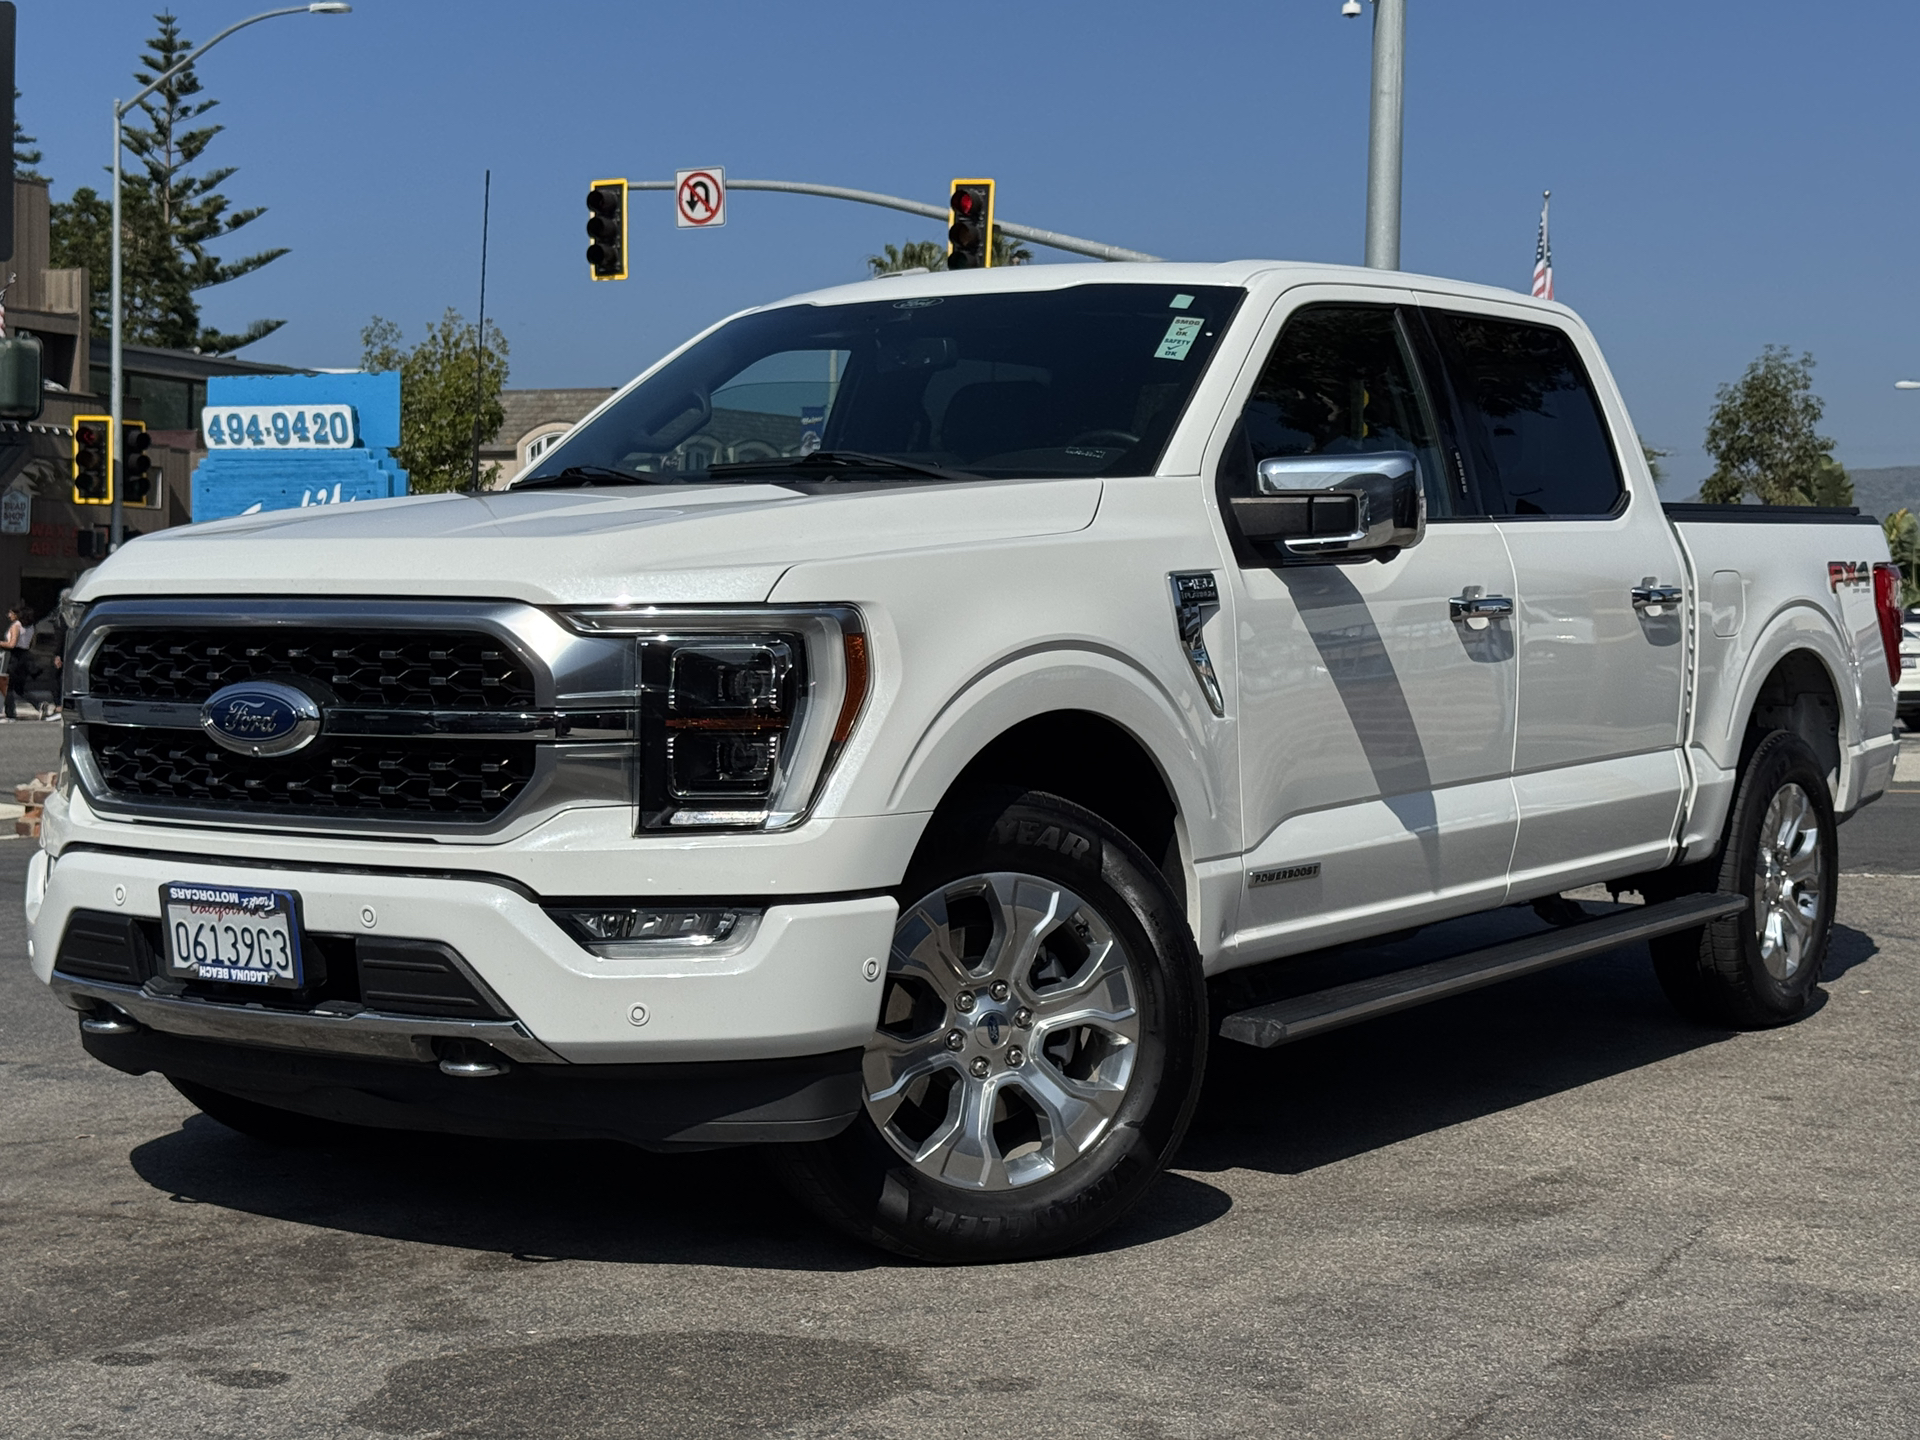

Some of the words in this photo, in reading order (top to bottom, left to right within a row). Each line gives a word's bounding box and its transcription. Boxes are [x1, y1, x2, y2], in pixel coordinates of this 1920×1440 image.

[1164, 338, 1191, 346] SAFETY
[224, 699, 279, 732] Ford
[1254, 866, 1319, 884] POWERBOOST
[169, 887, 239, 904] MOTORCARS
[175, 921, 290, 972] 06139G3
[199, 965, 230, 979] BEACH
[231, 968, 269, 983] LAGUNA
